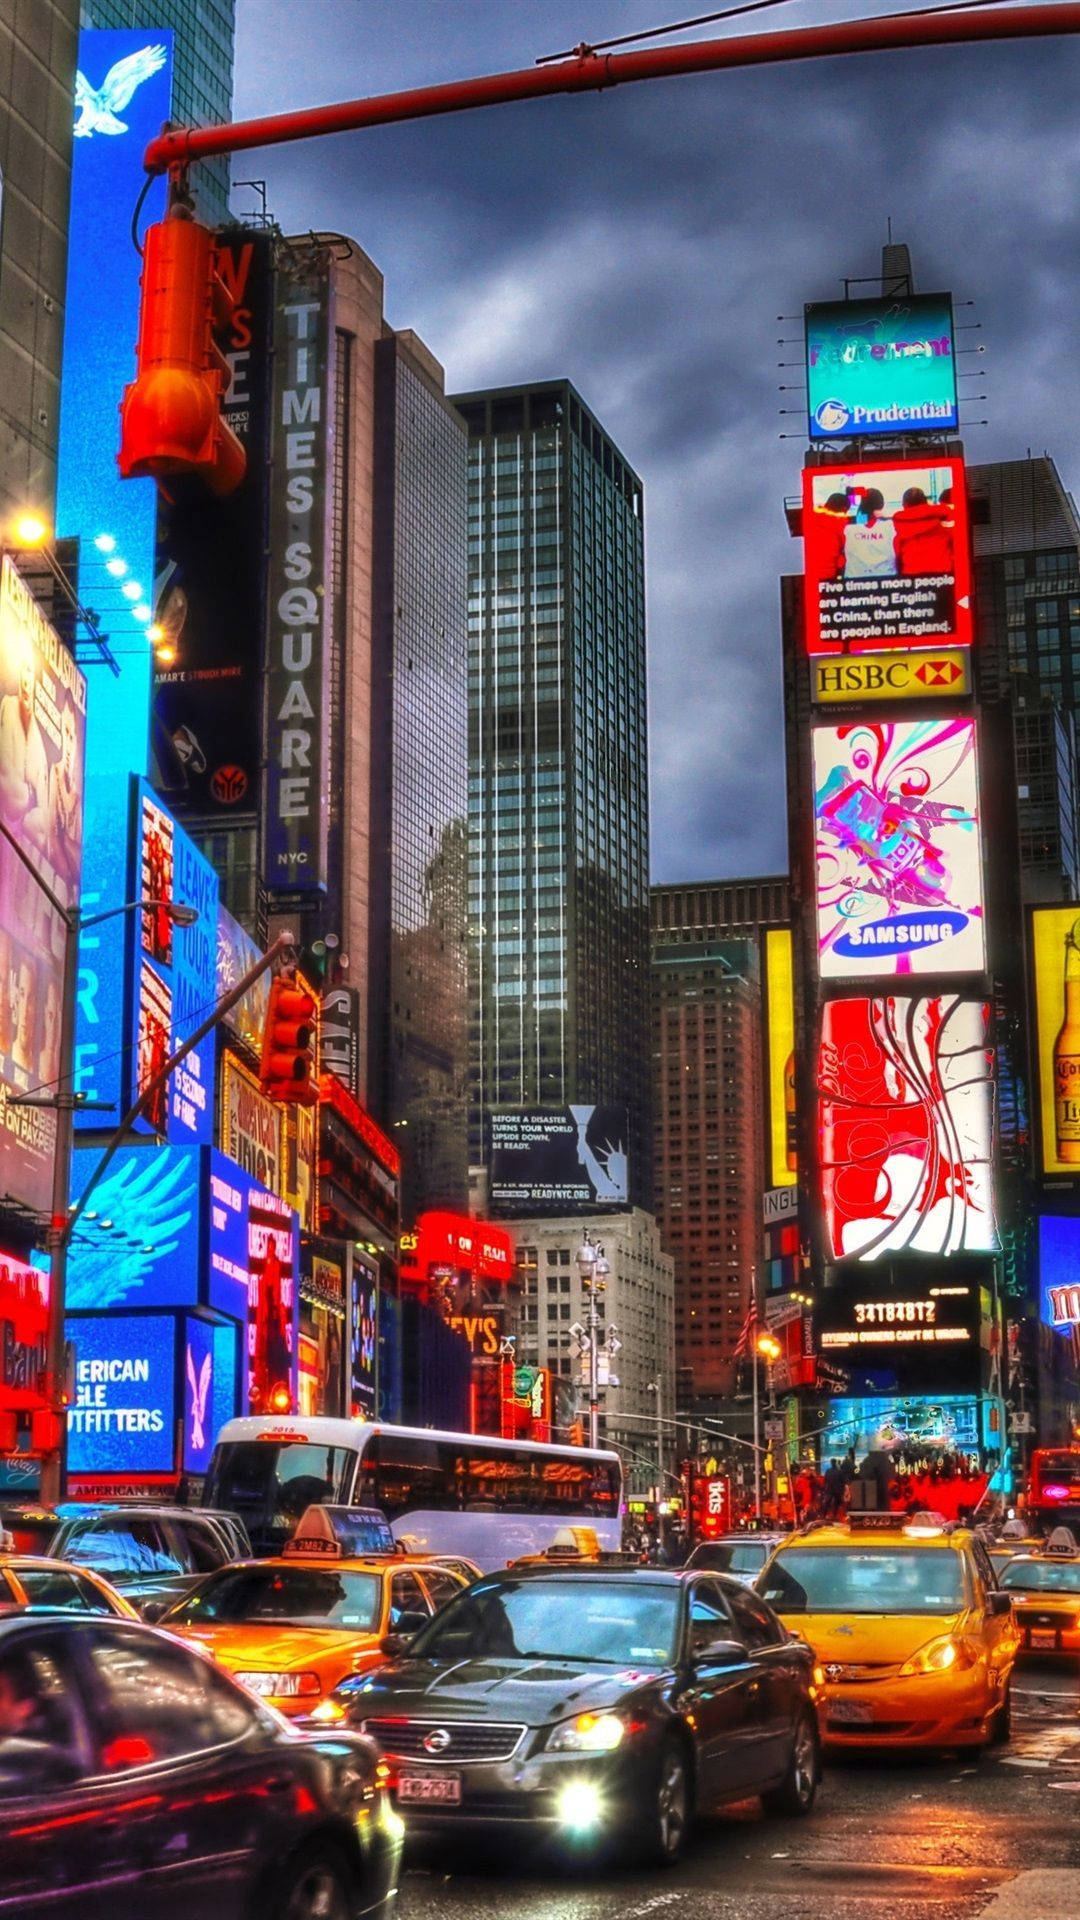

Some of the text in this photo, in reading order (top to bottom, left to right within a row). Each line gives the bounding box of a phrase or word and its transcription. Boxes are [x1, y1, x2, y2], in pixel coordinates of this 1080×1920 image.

[853, 400, 952, 424] Prudential
[276, 302, 321, 818] TIMES SQUARE
[818, 574, 955, 593] Five times more people
[819, 591, 937, 608] are learning English
[833, 610, 872, 623] China,
[874, 609, 900, 620] than
[903, 607, 935, 619] there
[819, 621, 952, 640] are people in England.
[818, 662, 910, 692] HSBC
[278, 851, 309, 866] NYC
[849, 923, 954, 946] SAMSUNG
[492, 1115, 521, 1123] BEFORE
[531, 1116, 567, 1124] DISASTER
[492, 1124, 518, 1132] TURNS
[544, 1125, 573, 1133] WORLD
[492, 1133, 519, 1141] UPSIDE
[492, 1142, 502, 1150] BE
[531, 1189, 590, 1200] READYNYC.ORG
[860, 1330, 895, 1342] OWNERS
[896, 1329, 922, 1341] CAN'T
[67, 1408, 164, 1433] UTFITTERS
[75, 1485, 145, 1497] AMERICAN
[708, 1481, 726, 1514] tkts
